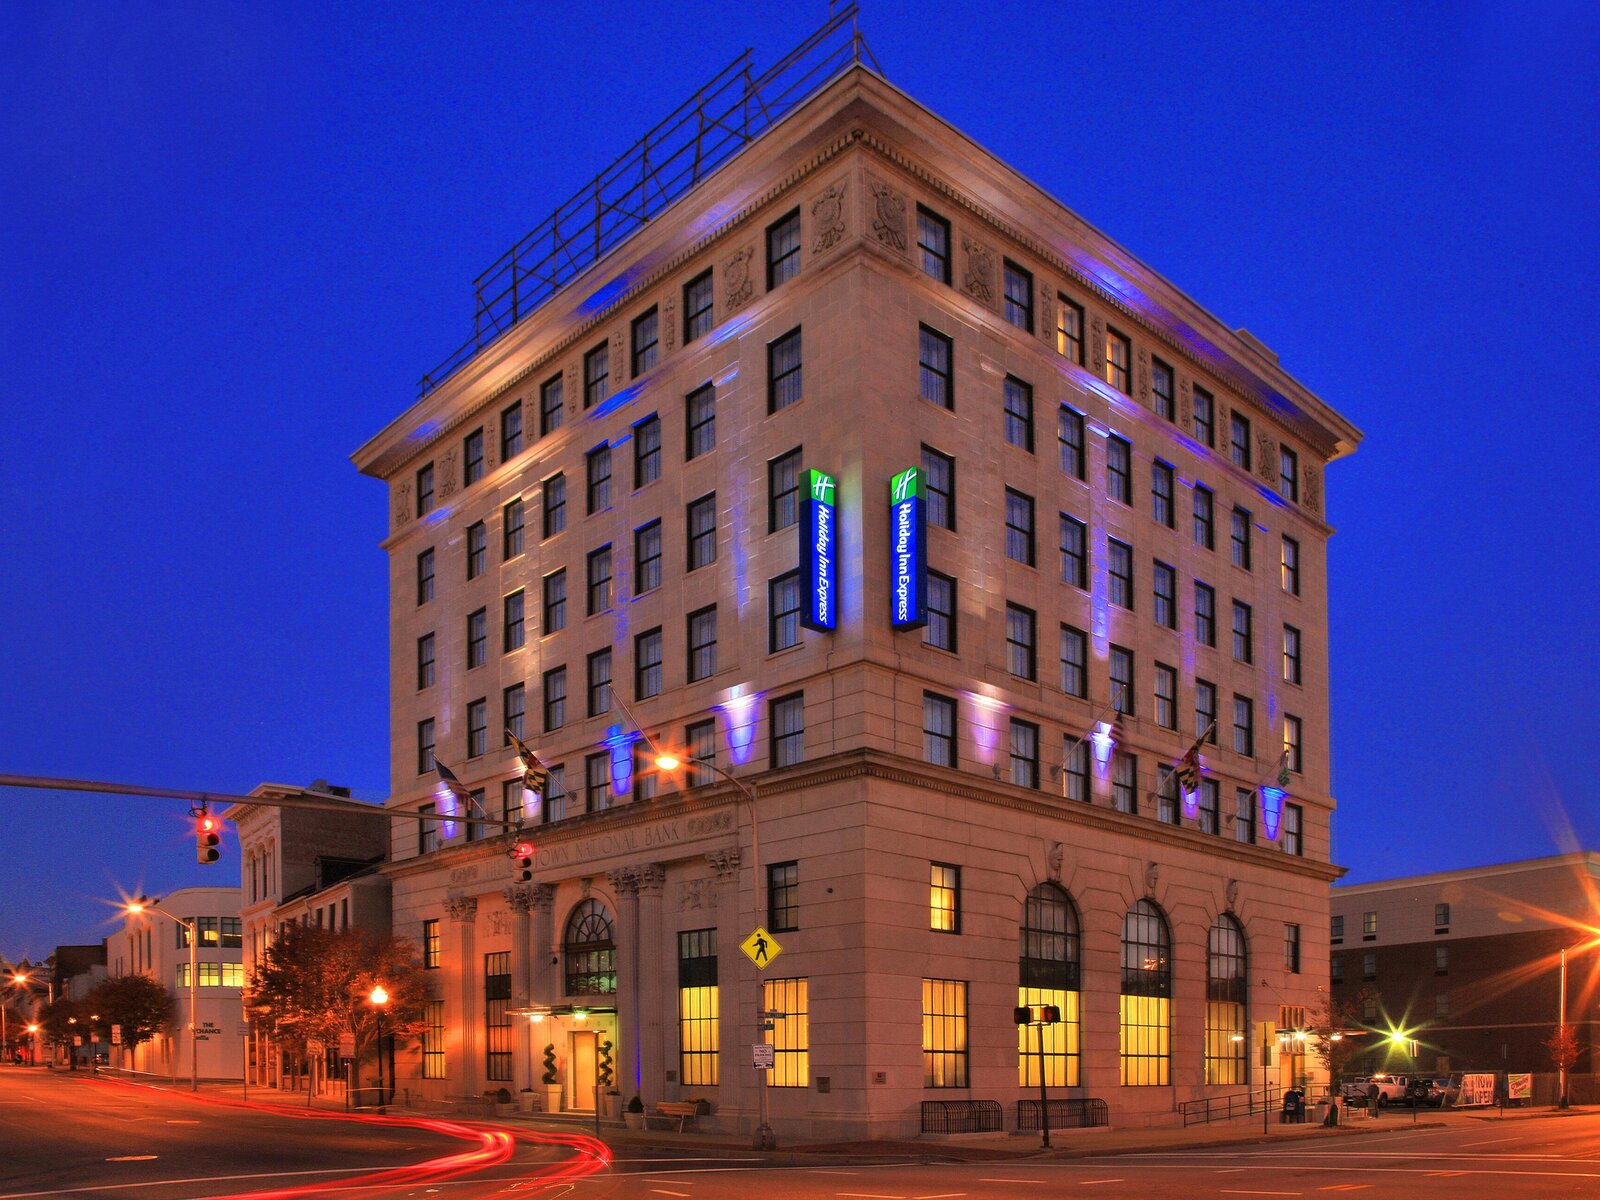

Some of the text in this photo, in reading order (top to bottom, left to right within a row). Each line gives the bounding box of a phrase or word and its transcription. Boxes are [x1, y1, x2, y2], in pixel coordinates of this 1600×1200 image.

[816, 504, 830, 623] Holiday Inn Express
[897, 503, 911, 620] Holiday Inn Express
[575, 830, 639, 860] NATIONAL
[645, 821, 680, 846] BANK
[1474, 1075, 1493, 1088] NOW
[1474, 1090, 1493, 1104] OPEN
